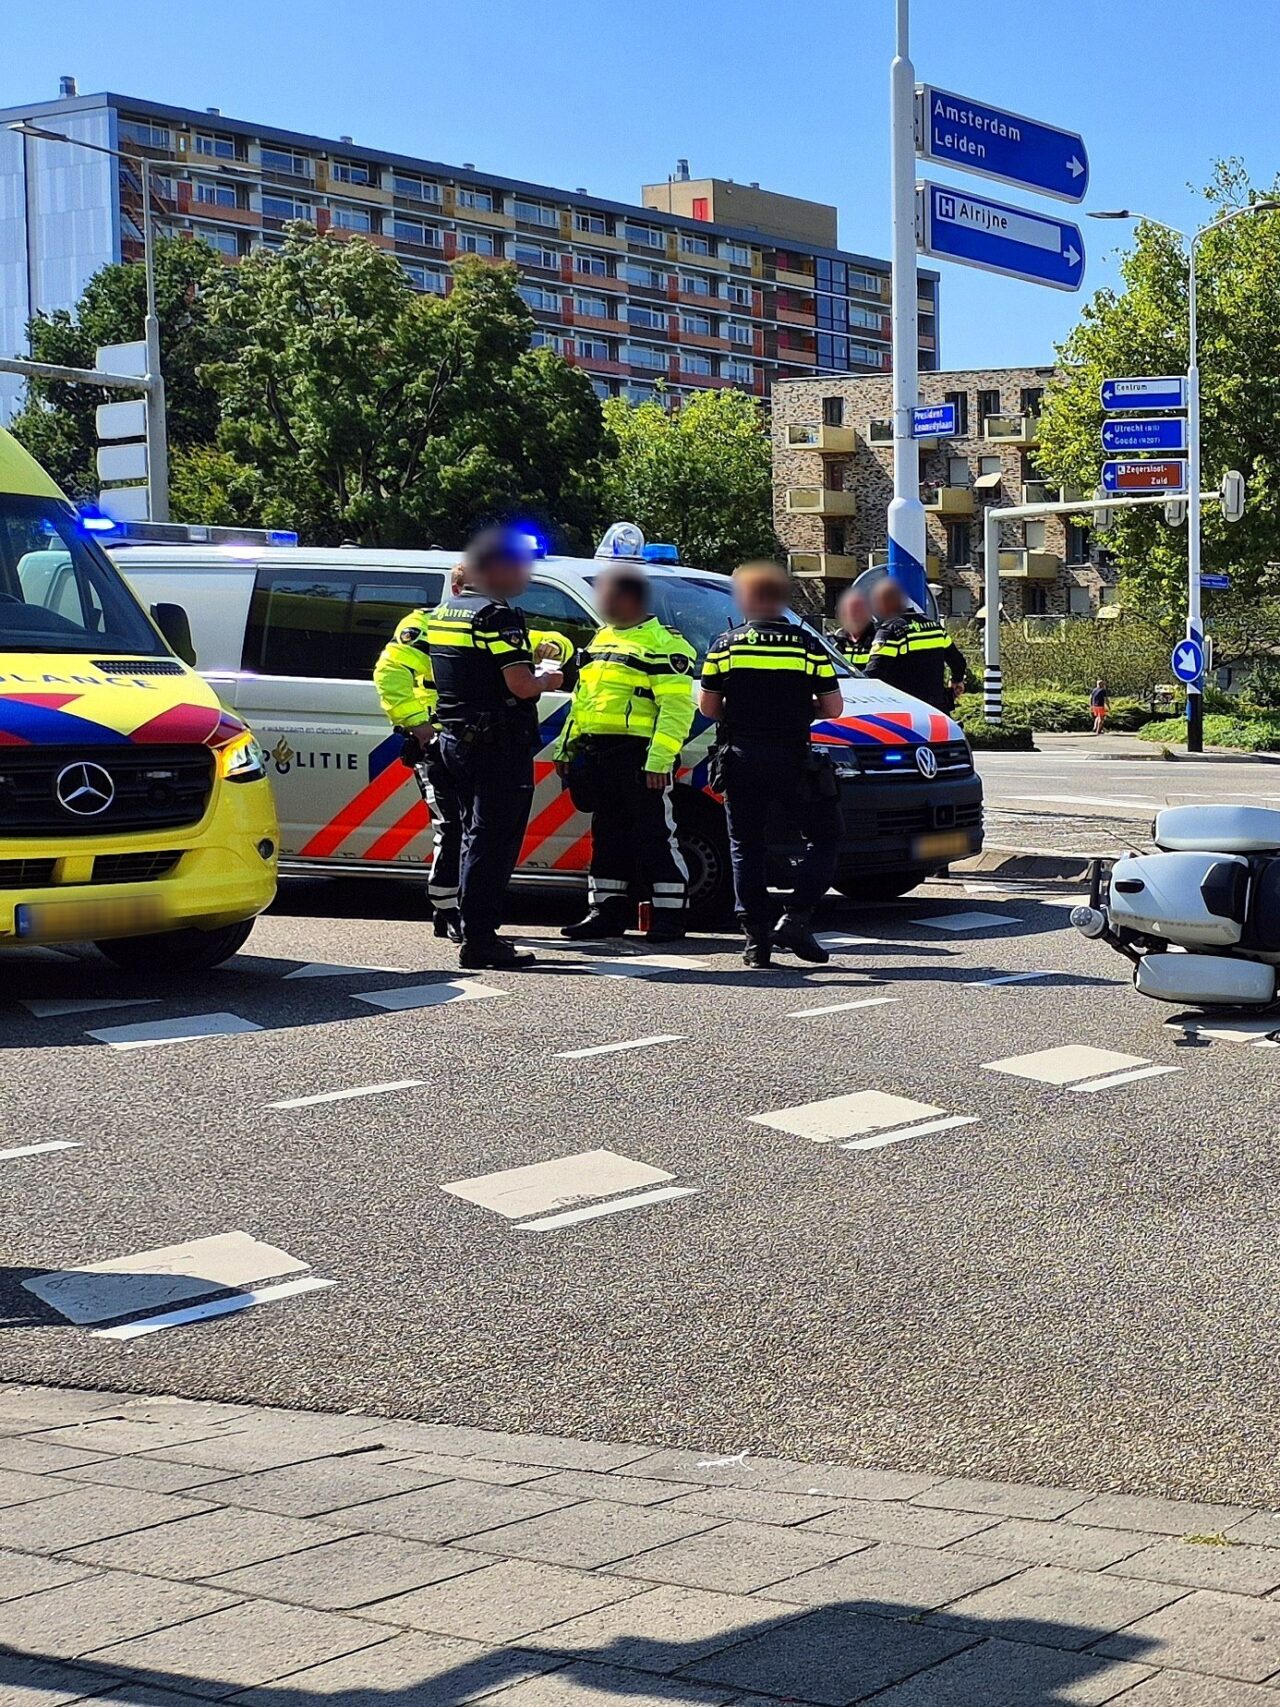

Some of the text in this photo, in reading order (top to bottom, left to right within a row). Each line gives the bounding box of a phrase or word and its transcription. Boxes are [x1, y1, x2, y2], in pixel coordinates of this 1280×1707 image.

[934, 99, 1021, 142] Amsterdam
[935, 127, 986, 158] Leiden
[960, 202, 1008, 229] Alrijne
[1116, 384, 1148, 392] Centrum
[914, 409, 943, 420] President
[1114, 424, 1144, 433] Utrecht
[1114, 437, 1137, 445] Gouda
[1150, 477, 1168, 485] Zuid
[738, 632, 799, 645] POLITIE
